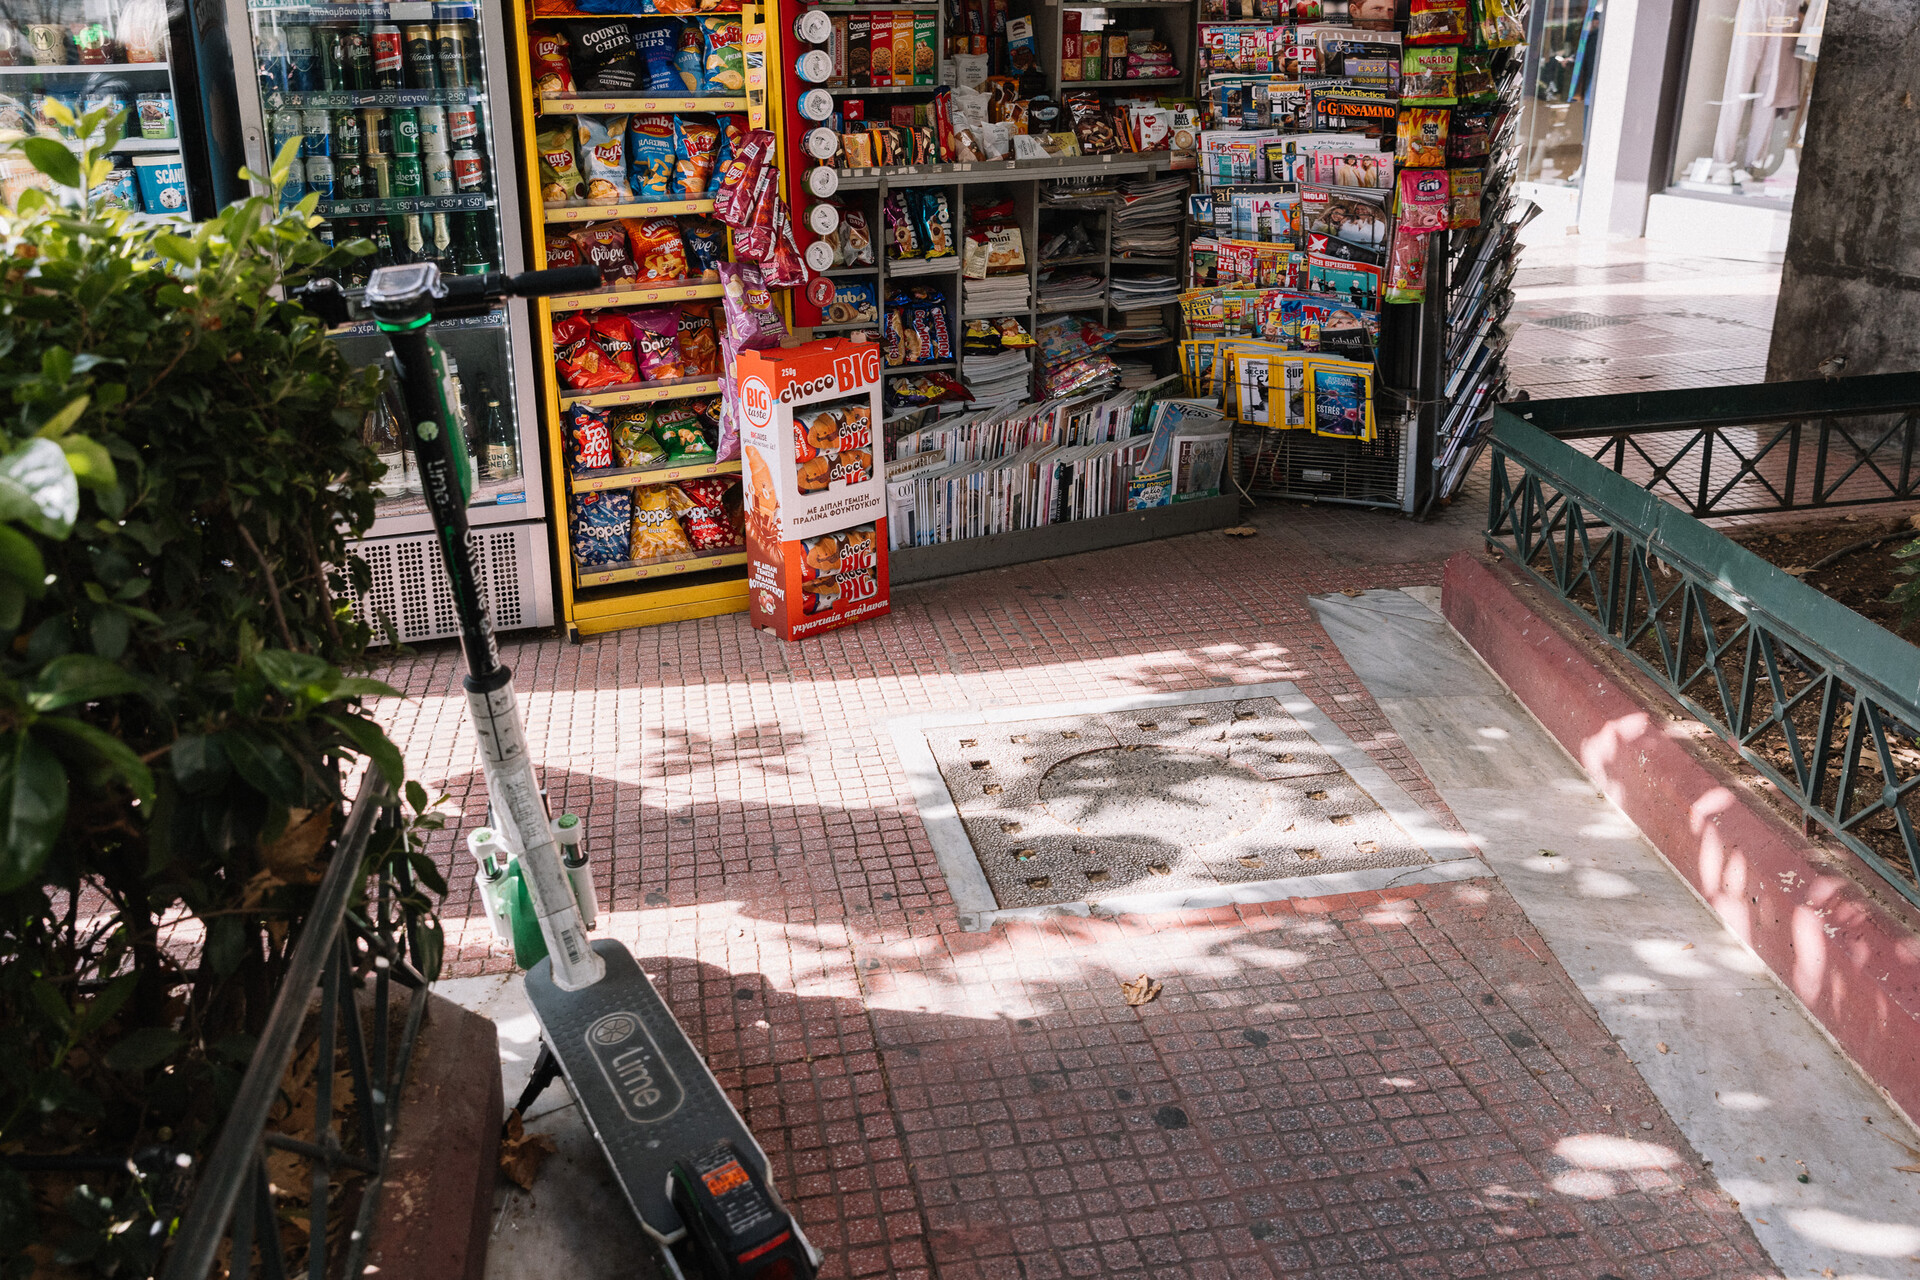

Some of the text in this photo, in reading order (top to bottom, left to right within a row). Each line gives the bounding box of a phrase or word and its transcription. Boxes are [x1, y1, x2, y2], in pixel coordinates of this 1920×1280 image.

[849, 21, 870, 31] Cookies
[871, 21, 892, 30] Cookies
[893, 20, 914, 30] Cookies
[914, 20, 935, 30] Cookies
[635, 28, 671, 40] UNTRY
[746, 33, 764, 45] Lay's
[1224, 33, 1240, 42] Tak
[595, 34, 631, 53] CHIPS
[636, 38, 664, 49] HIPS
[1224, 42, 1240, 50] Bre
[1418, 55, 1453, 64] HARIBO
[620, 79, 632, 88] FREE
[634, 116, 674, 129] Jumbo
[596, 145, 622, 162] Lay's
[1418, 180, 1440, 192] Fini
[1454, 175, 1479, 185] HARIBO
[1414, 193, 1436, 202] Strawberry
[595, 230, 613, 240] Lay's
[989, 233, 1011, 244] mini
[1218, 257, 1243, 273] Frau
[1310, 257, 1357, 270] DER SPIEGEL
[749, 290, 769, 305] Lay's
[677, 318, 713, 332] Doritos
[914, 309, 931, 359] CHAMPION
[779, 349, 880, 404] choco BIG
[781, 368, 796, 377] 250g
[746, 387, 767, 411] BIG
[748, 408, 767, 420] taste
[1316, 404, 1340, 415] ESTRÉS
[838, 417, 868, 438] choco
[839, 428, 869, 452] BIG
[586, 454, 612, 468] nia
[427, 459, 449, 505] Lime
[819, 502, 843, 512] ΔΙΠΛΗ
[844, 493, 870, 505] ΓΕΜΙΣΗ
[634, 506, 672, 527] Poppe
[687, 506, 722, 522] oppers
[792, 497, 881, 525] ΠΡΑΛΙΝΑ ΦΟΥΝΤΟΥΚΙΟΥ
[578, 520, 631, 541] Poppers
[840, 538, 871, 559] choco
[840, 547, 872, 574] BIG
[756, 567, 775, 579] ΓΕΜΙΣΗ
[761, 562, 777, 574] ΔΙΠΛΗ
[754, 574, 777, 587] ΠΡΑΛΙΝΑ
[835, 568, 868, 583] choco
[749, 578, 785, 601] ΦΟΥΝΤΟΥΚΙΟΥ
[839, 575, 876, 603] BIG
[792, 599, 889, 635] γιγαντιαία απόλαυση
[611, 1046, 661, 1107] Lime
